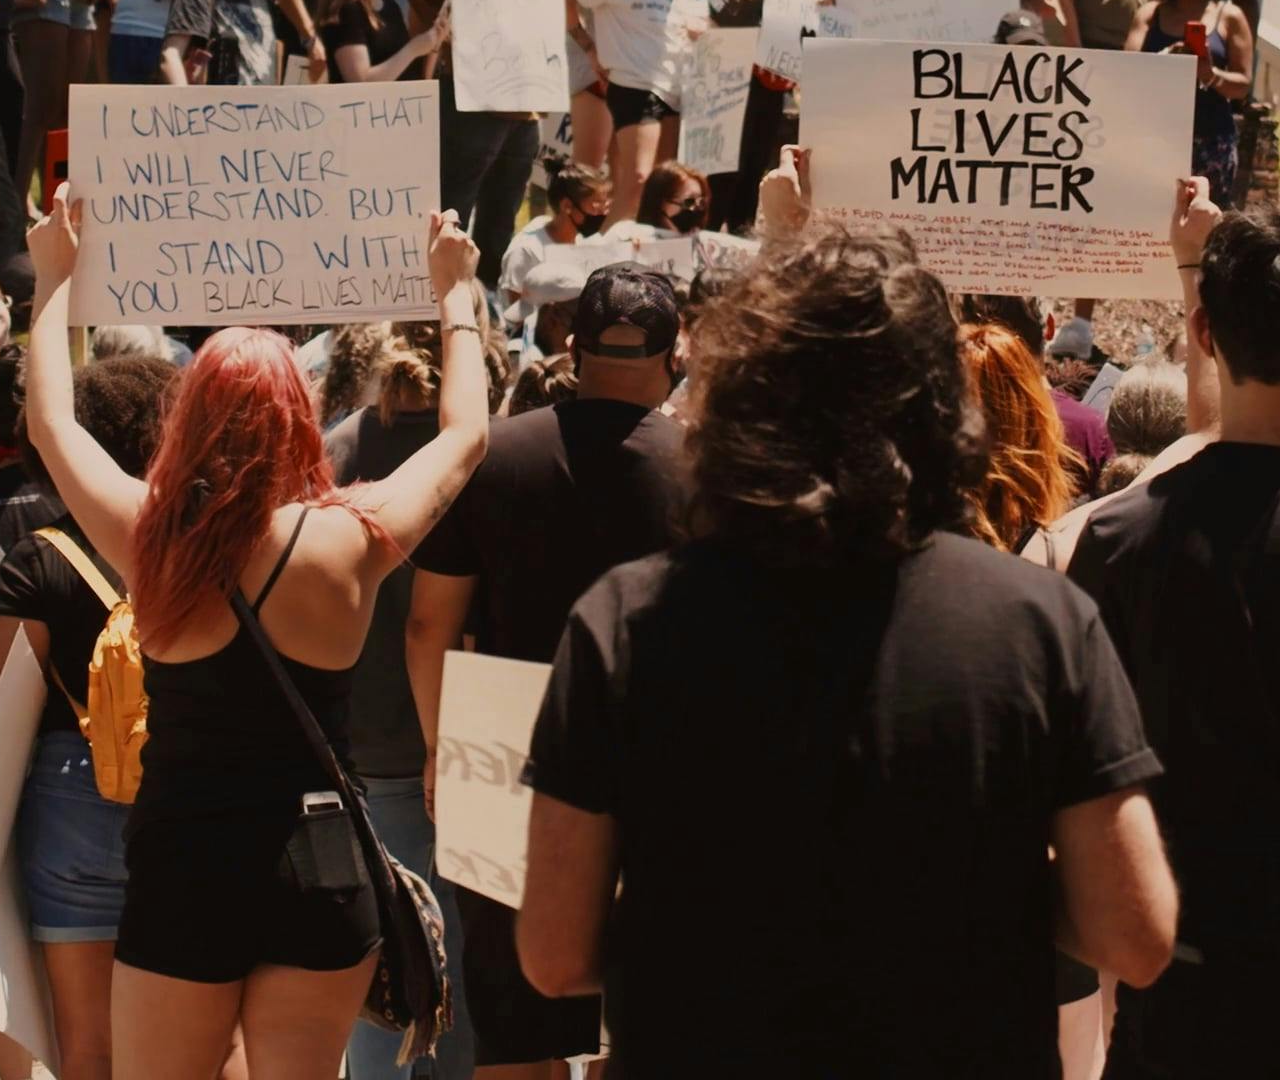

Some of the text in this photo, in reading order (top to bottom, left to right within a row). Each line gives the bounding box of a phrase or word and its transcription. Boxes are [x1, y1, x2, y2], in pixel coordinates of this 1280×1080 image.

[911, 48, 1092, 107] BLACK
[102, 94, 433, 139] I UNDERSTAND THAT
[910, 107, 1091, 162] LIVES
[96, 149, 350, 187] I WILL NEVER
[889, 155, 1095, 214] MATTER
[109, 234, 421, 277] I STAND WITH
[202, 279, 293, 313] BLACK
[301, 276, 363, 310] LIVES
[372, 273, 438, 305] MATTE
